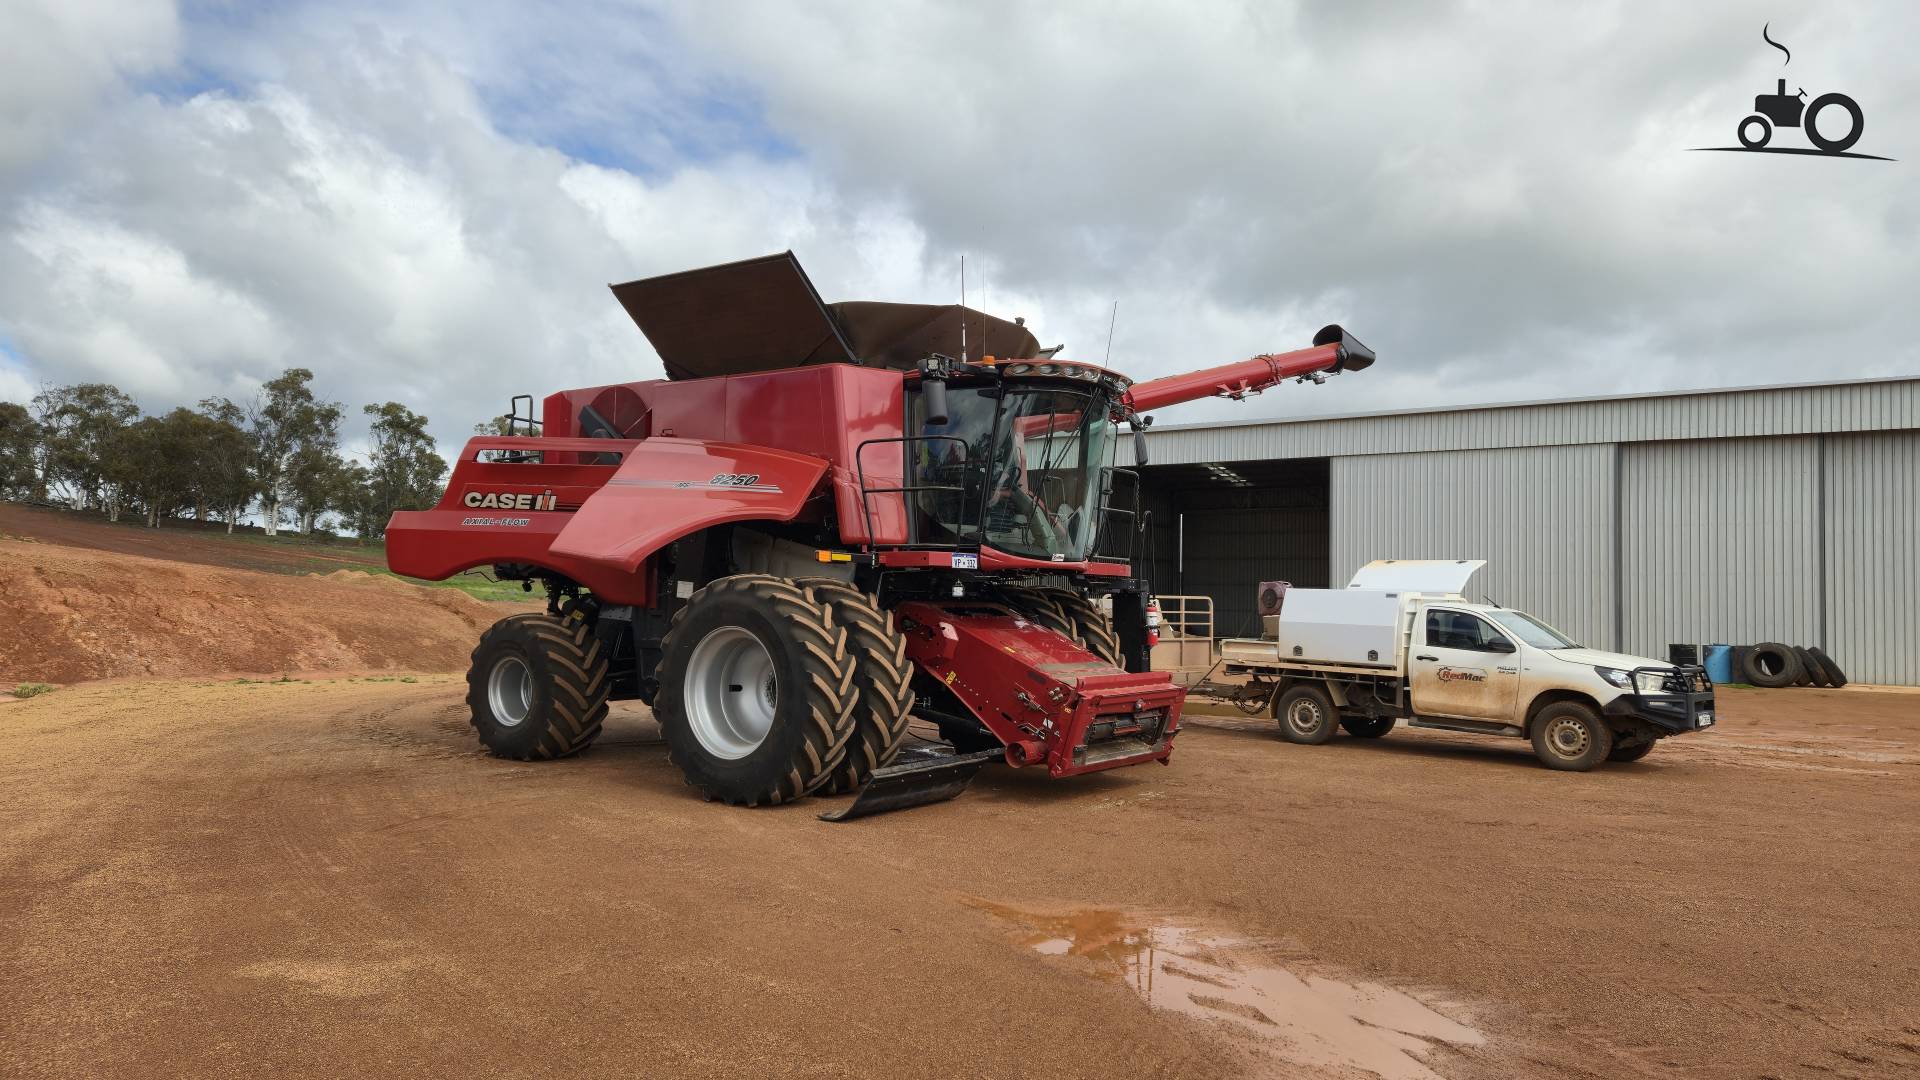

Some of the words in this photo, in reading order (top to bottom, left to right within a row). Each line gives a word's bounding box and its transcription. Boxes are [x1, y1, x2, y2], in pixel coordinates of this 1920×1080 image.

[710, 473, 759, 486] 8250
[464, 491, 532, 509] CASE
[462, 517, 530, 526] AXIAL-FLOW
[1442, 671, 1486, 682] RedMac
